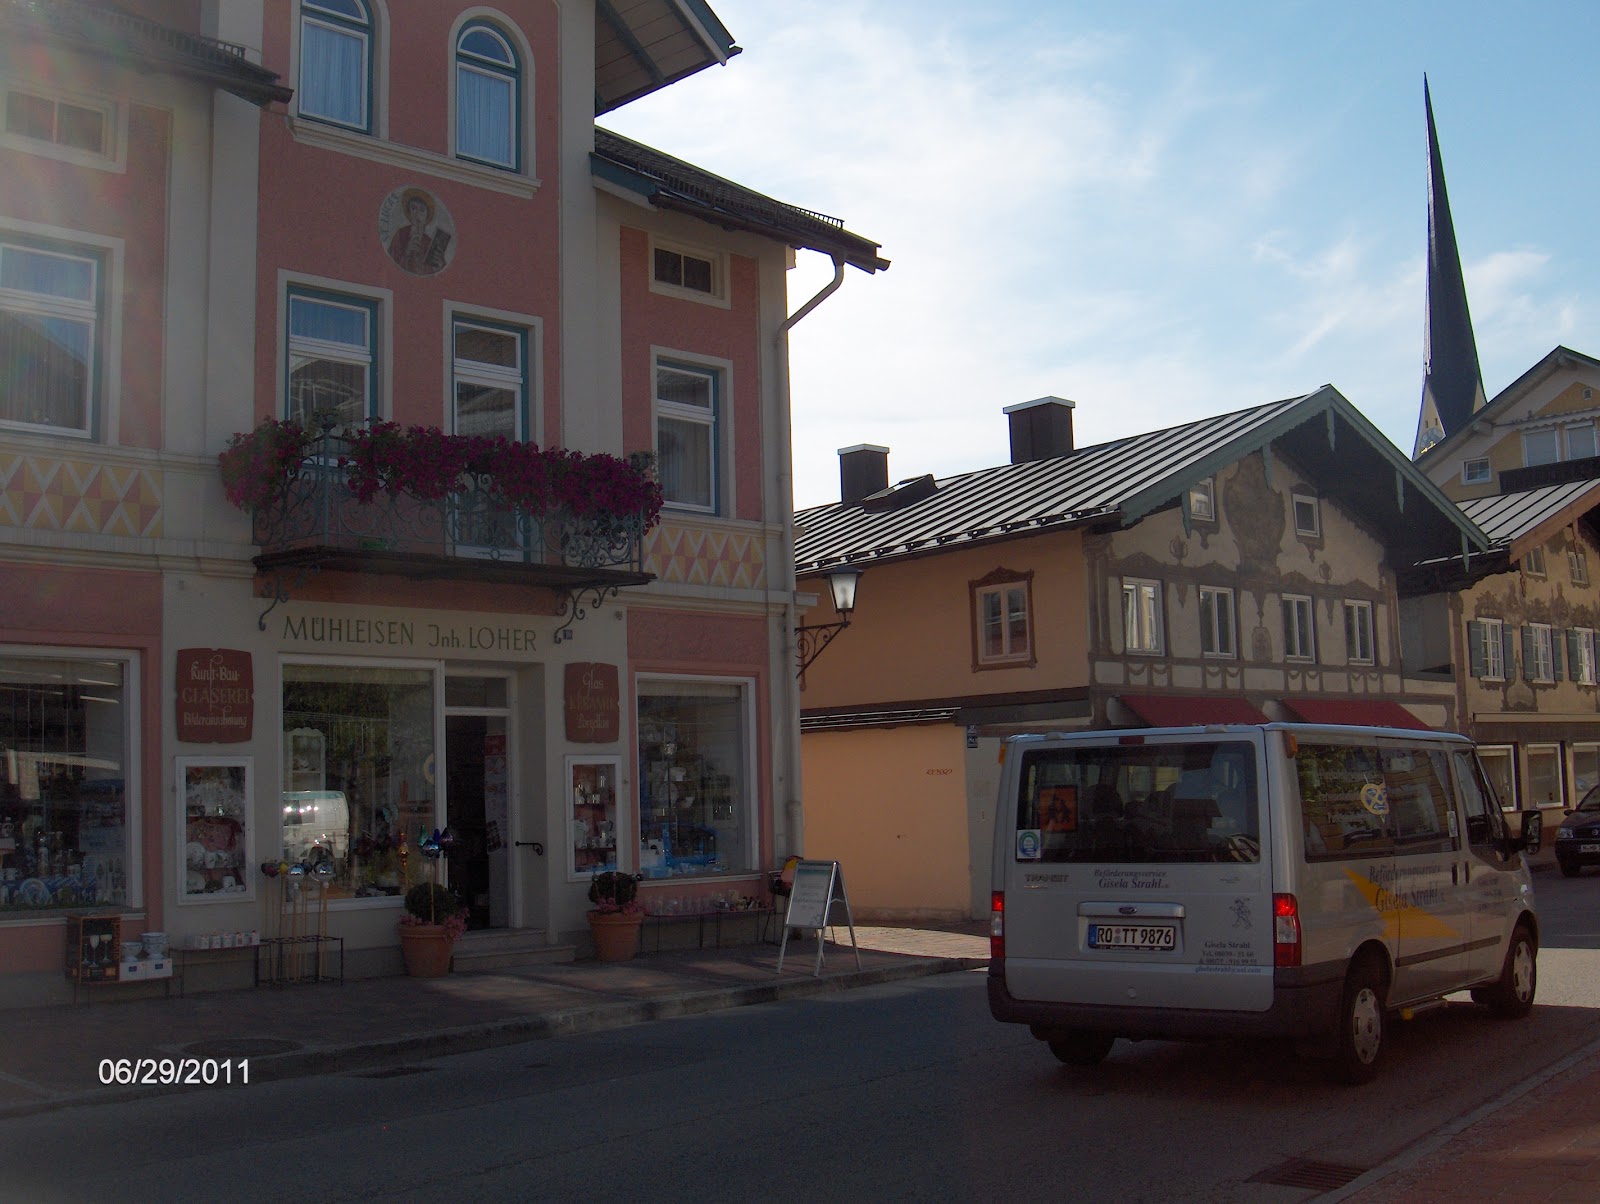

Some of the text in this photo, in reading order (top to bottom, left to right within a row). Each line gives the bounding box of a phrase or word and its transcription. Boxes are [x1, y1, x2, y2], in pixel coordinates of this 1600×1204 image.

[468, 627, 538, 652] LOHER
[582, 669, 604, 697] Glas
[181, 687, 250, 704] GLASEREI
[1023, 873, 1070, 883] TRANSIT
[1098, 878, 1129, 889] Gisela
[1131, 878, 1162, 889] Strahl
[1375, 887, 1409, 912] Gisela
[1097, 928, 1172, 945] RO TT 9876
[1204, 941, 1250, 949] Gisela Strahl
